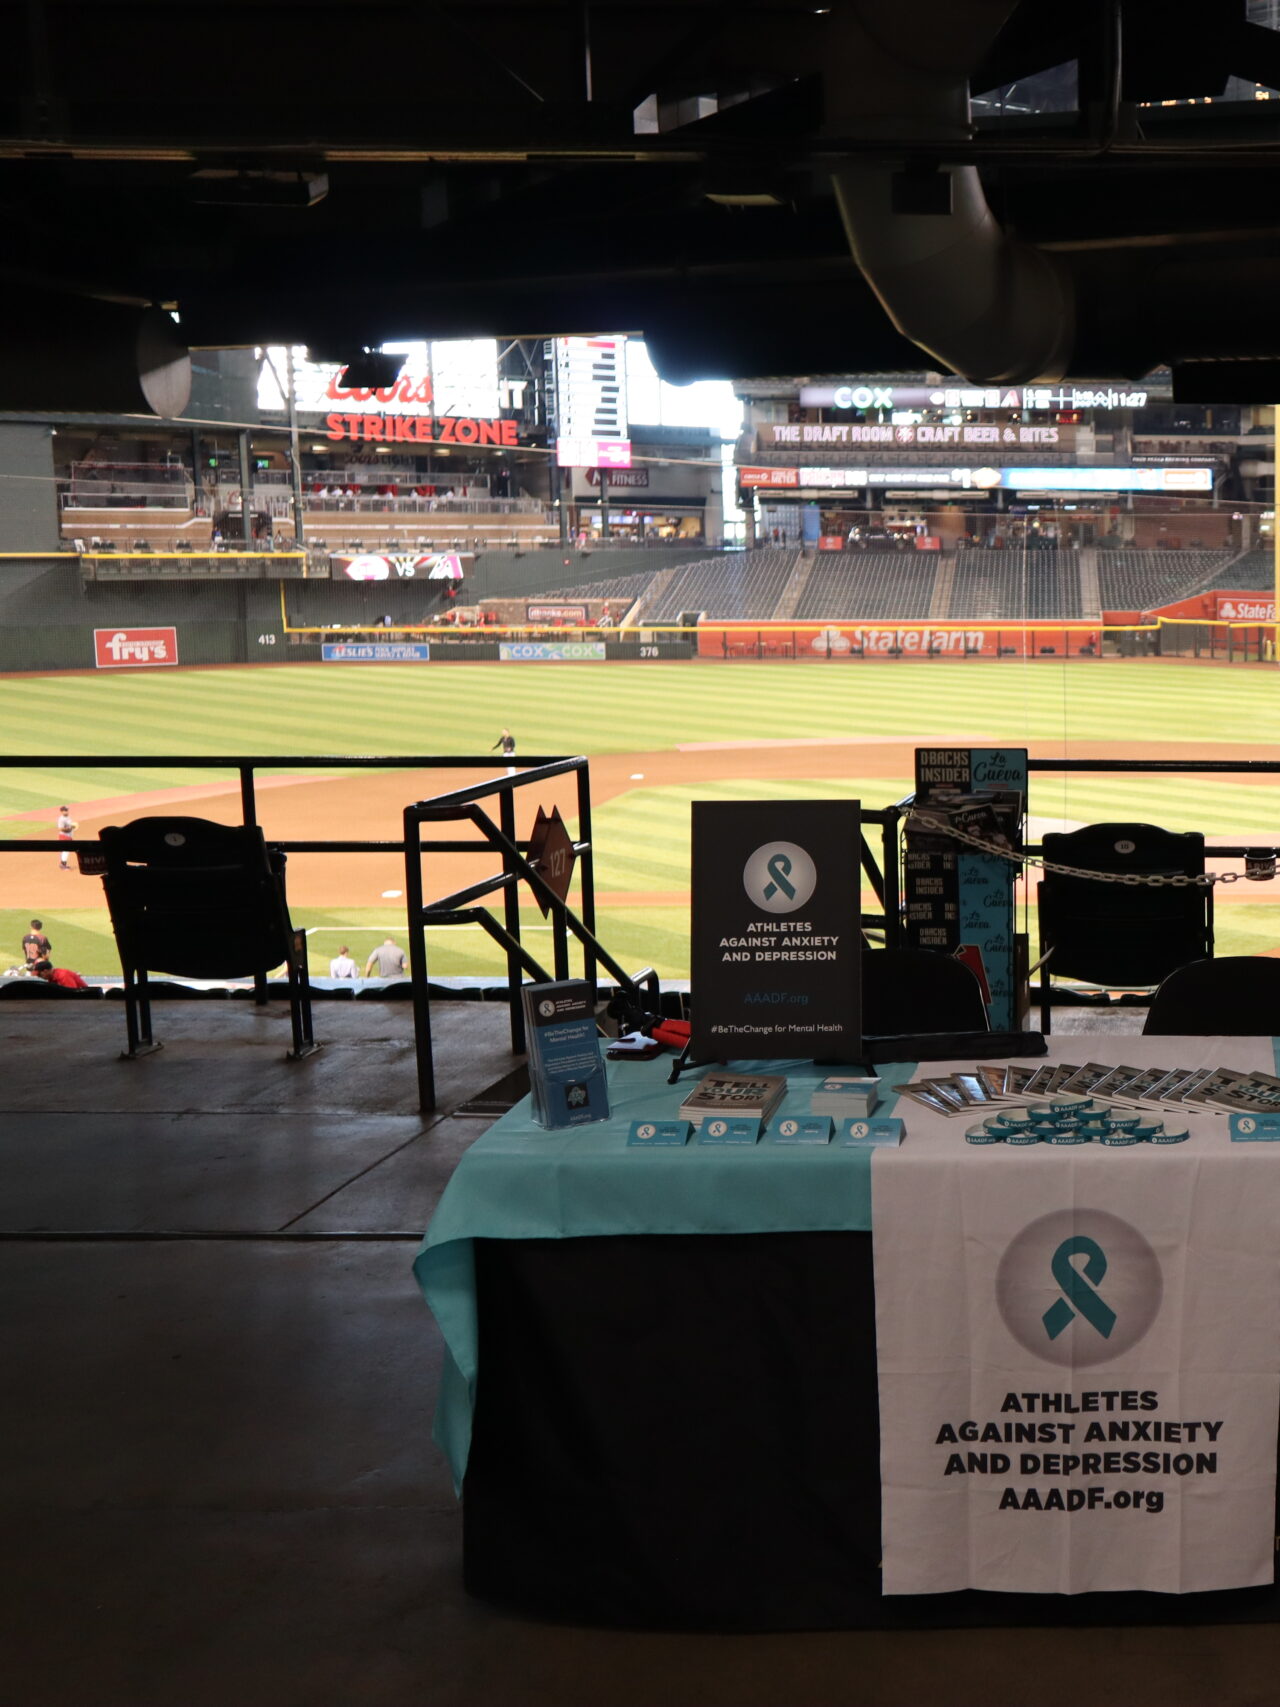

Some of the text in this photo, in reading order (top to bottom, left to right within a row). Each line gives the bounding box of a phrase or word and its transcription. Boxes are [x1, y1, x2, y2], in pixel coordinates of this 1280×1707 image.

[834, 387, 893, 409] COX
[326, 414, 518, 445] STRIKE ZONE
[773, 426, 1059, 442] THE DRAFT ROOM CRAFT BEER & BITES
[612, 475, 647, 486] FITNESS
[395, 562, 415, 577] VS
[105, 633, 167, 661] fry's
[258, 634, 276, 645] 413
[512, 646, 543, 656] COX
[562, 646, 593, 656] COX
[990, 752, 1007, 768] La
[920, 767, 970, 783] INSIDER
[973, 762, 1023, 782] Cueva
[550, 848, 566, 878] 127
[747, 922, 812, 933] ATHLETES
[719, 936, 839, 947] AGAINST ANXIETY
[722, 951, 837, 962] AND DEPRESSION
[744, 993, 809, 1006] AAADF.org
[711, 1023, 843, 1035] #BeTheChange for Mental Health
[703, 1086, 768, 1096] YOUR
[708, 1079, 770, 1089] TELL
[696, 1092, 763, 1101] STORY
[1000, 1391, 1158, 1414] ATHLETES
[936, 1420, 1224, 1444] AGAINST ANXIETY
[944, 1452, 1218, 1476] AND DEPRESSION
[999, 1487, 1164, 1513] AAADF.org
